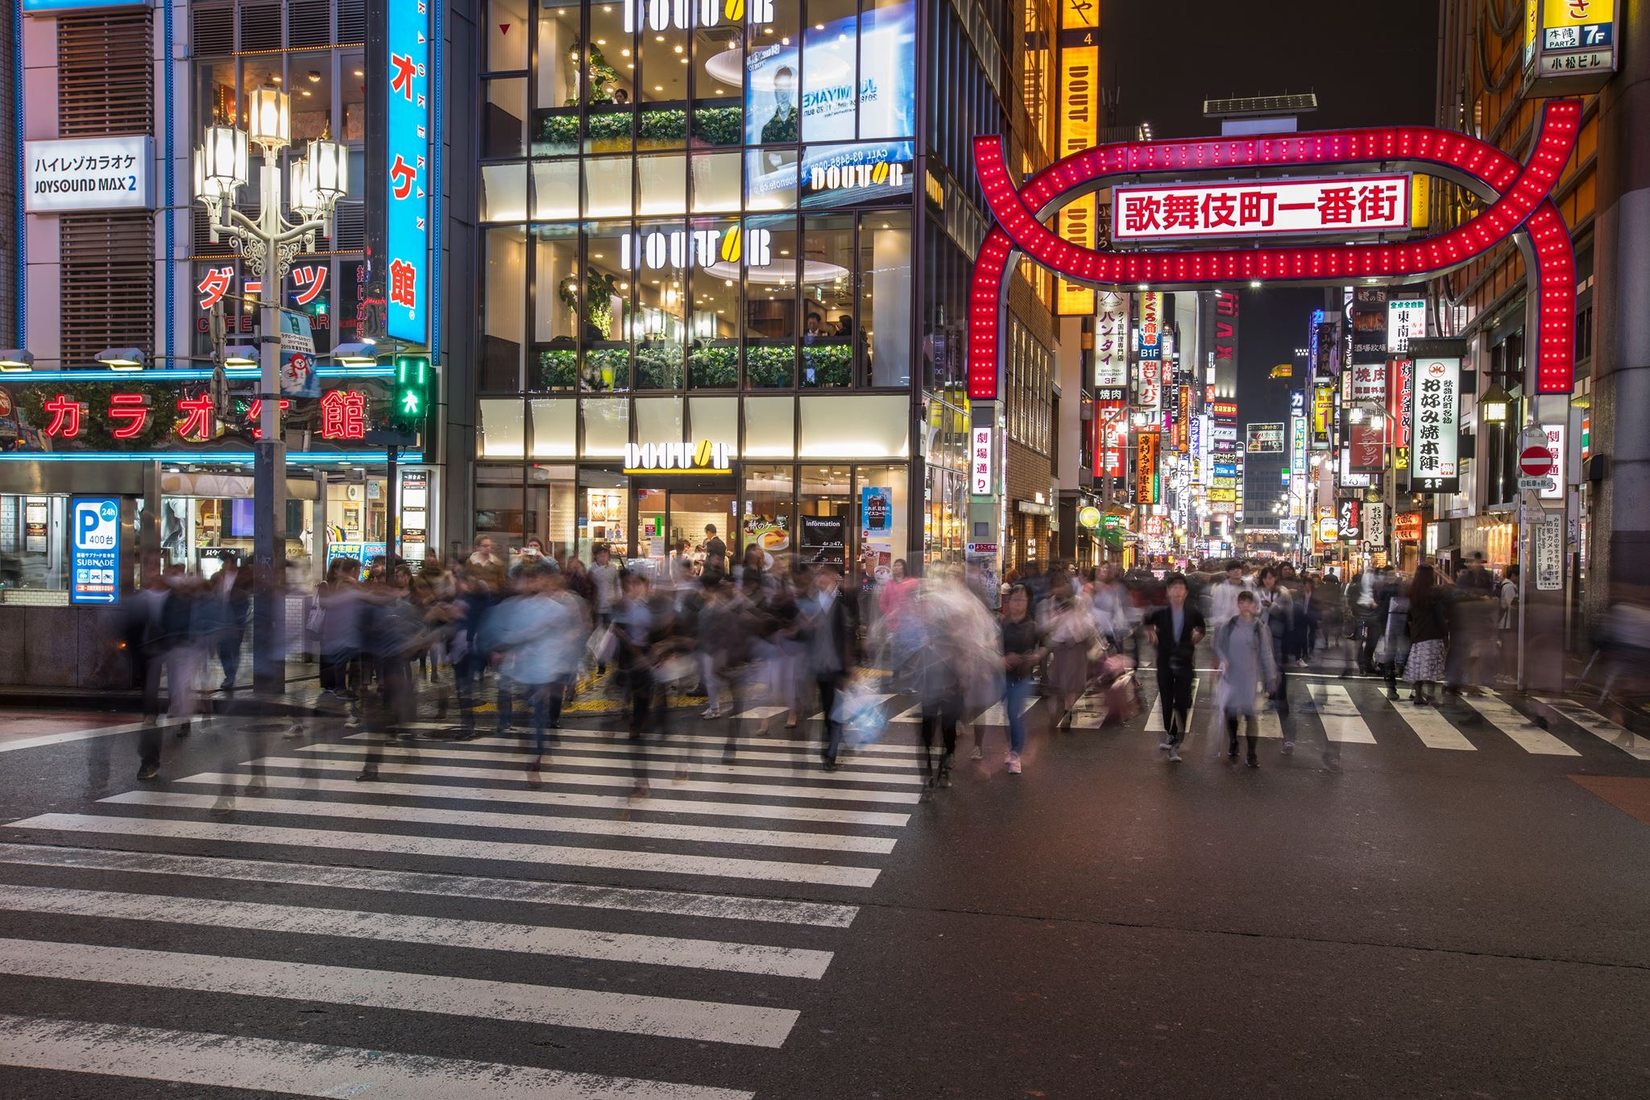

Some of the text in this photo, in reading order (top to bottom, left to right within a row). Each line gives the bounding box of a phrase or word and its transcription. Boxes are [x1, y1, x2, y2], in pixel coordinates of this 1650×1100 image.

[1584, 25, 1605, 45] 7F
[1551, 54, 1601, 70] 小松ビル
[34, 154, 137, 173] ハイレゾカラオケ
[34, 178, 96, 194] JOYSOUND
[128, 175, 137, 192] 2
[1125, 184, 1398, 232] 歌舞伎町一番街
[1099, 311, 1116, 366] バンタイ
[1117, 311, 1125, 362] タイ国料理専門店
[1140, 349, 1160, 358] B1F
[1099, 389, 1122, 400] 焼肉
[1420, 378, 1441, 471] お好み焼本陣
[624, 439, 730, 469] DOUTOR
[976, 432, 988, 490] 劇場通り
[1520, 480, 1552, 488] 自転車を除く
[101, 507, 116, 517] 24h
[79, 509, 100, 545] P
[748, 519, 786, 531] 秋のケーキ
[805, 519, 841, 528] information
[88, 535, 114, 545] 400台
[76, 559, 115, 567] SUBNADE
